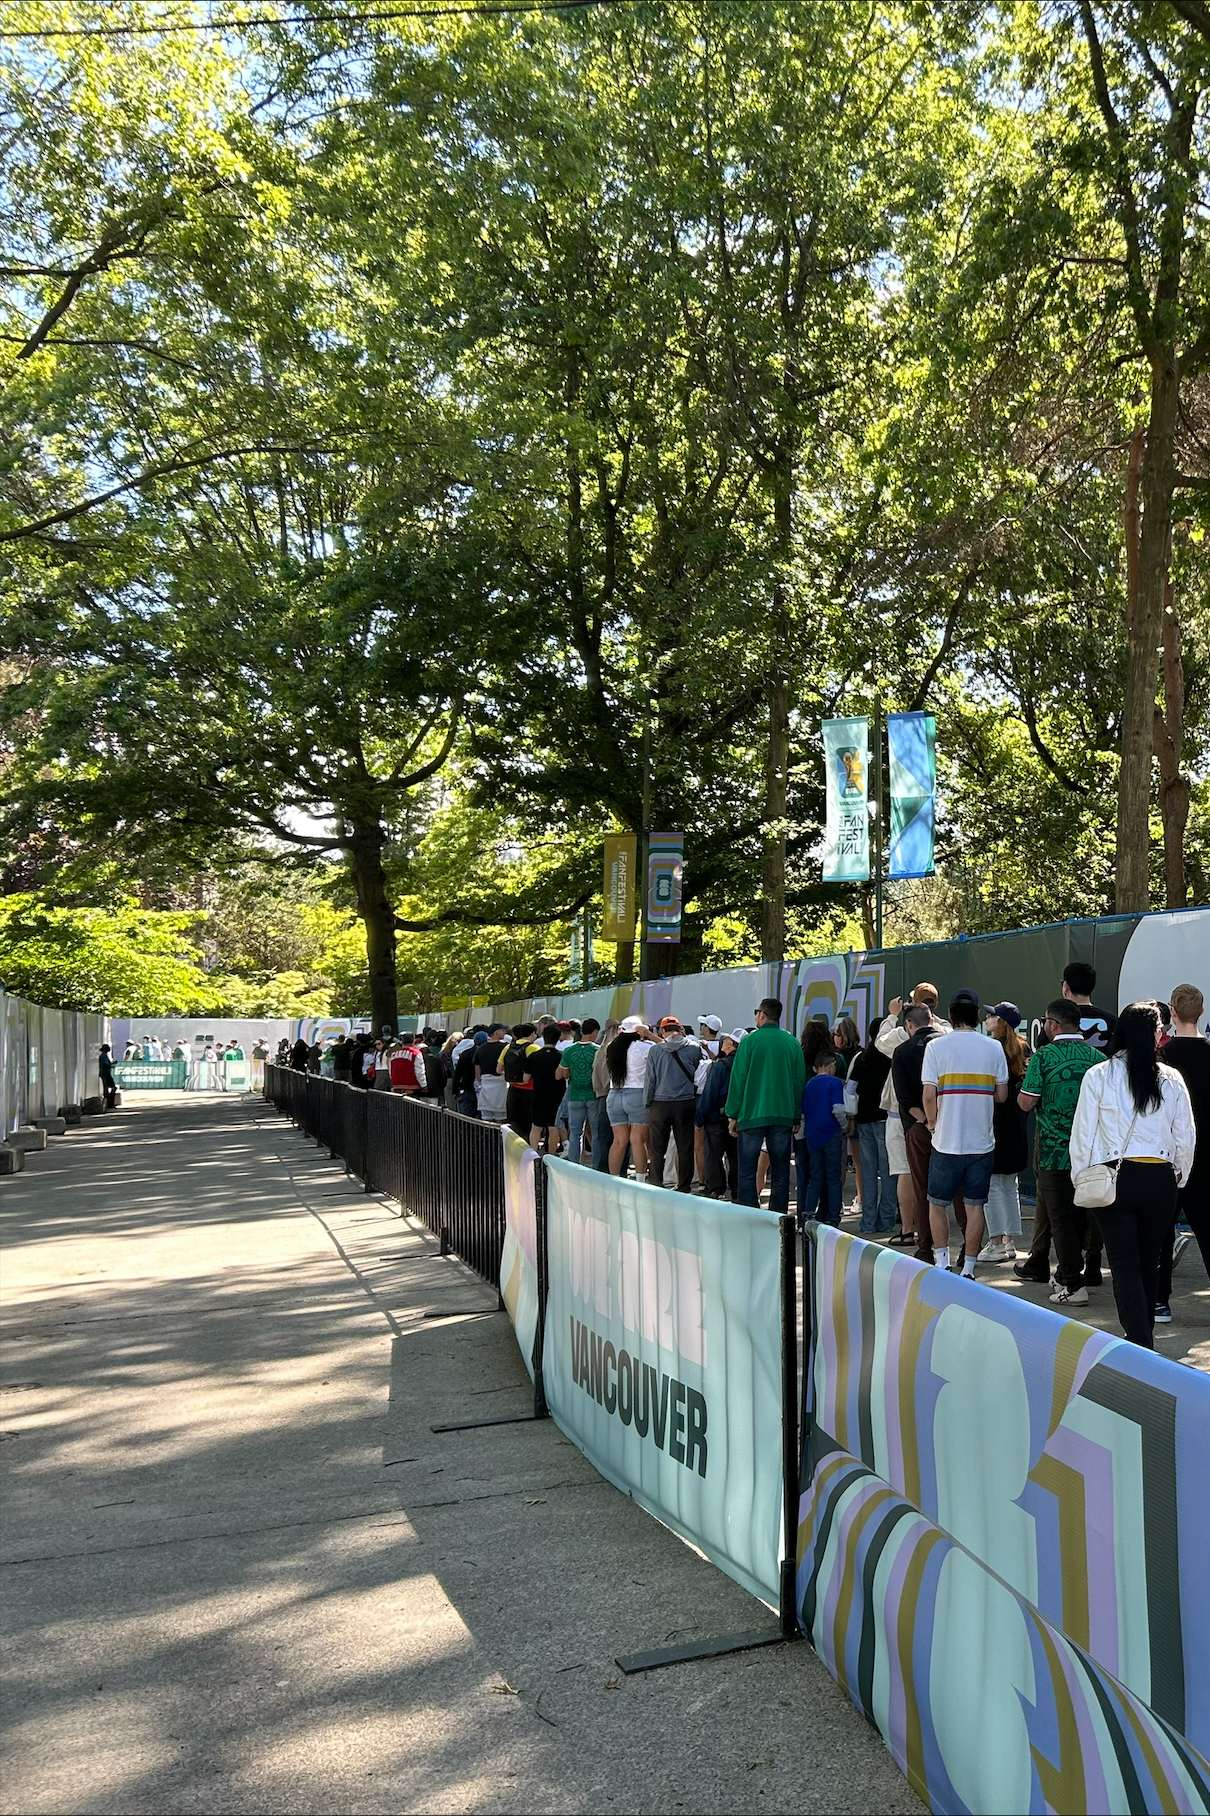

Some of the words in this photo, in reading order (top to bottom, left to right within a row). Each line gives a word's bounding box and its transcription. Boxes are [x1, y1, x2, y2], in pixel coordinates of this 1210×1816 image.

[838, 827, 864, 841] FEST
[844, 813, 864, 828] FAN
[610, 861, 618, 914] VANCOUVER
[391, 1050, 413, 1061] CANADA
[617, 1230, 708, 1369] ARE
[569, 1314, 709, 1480] VANCOUVER
